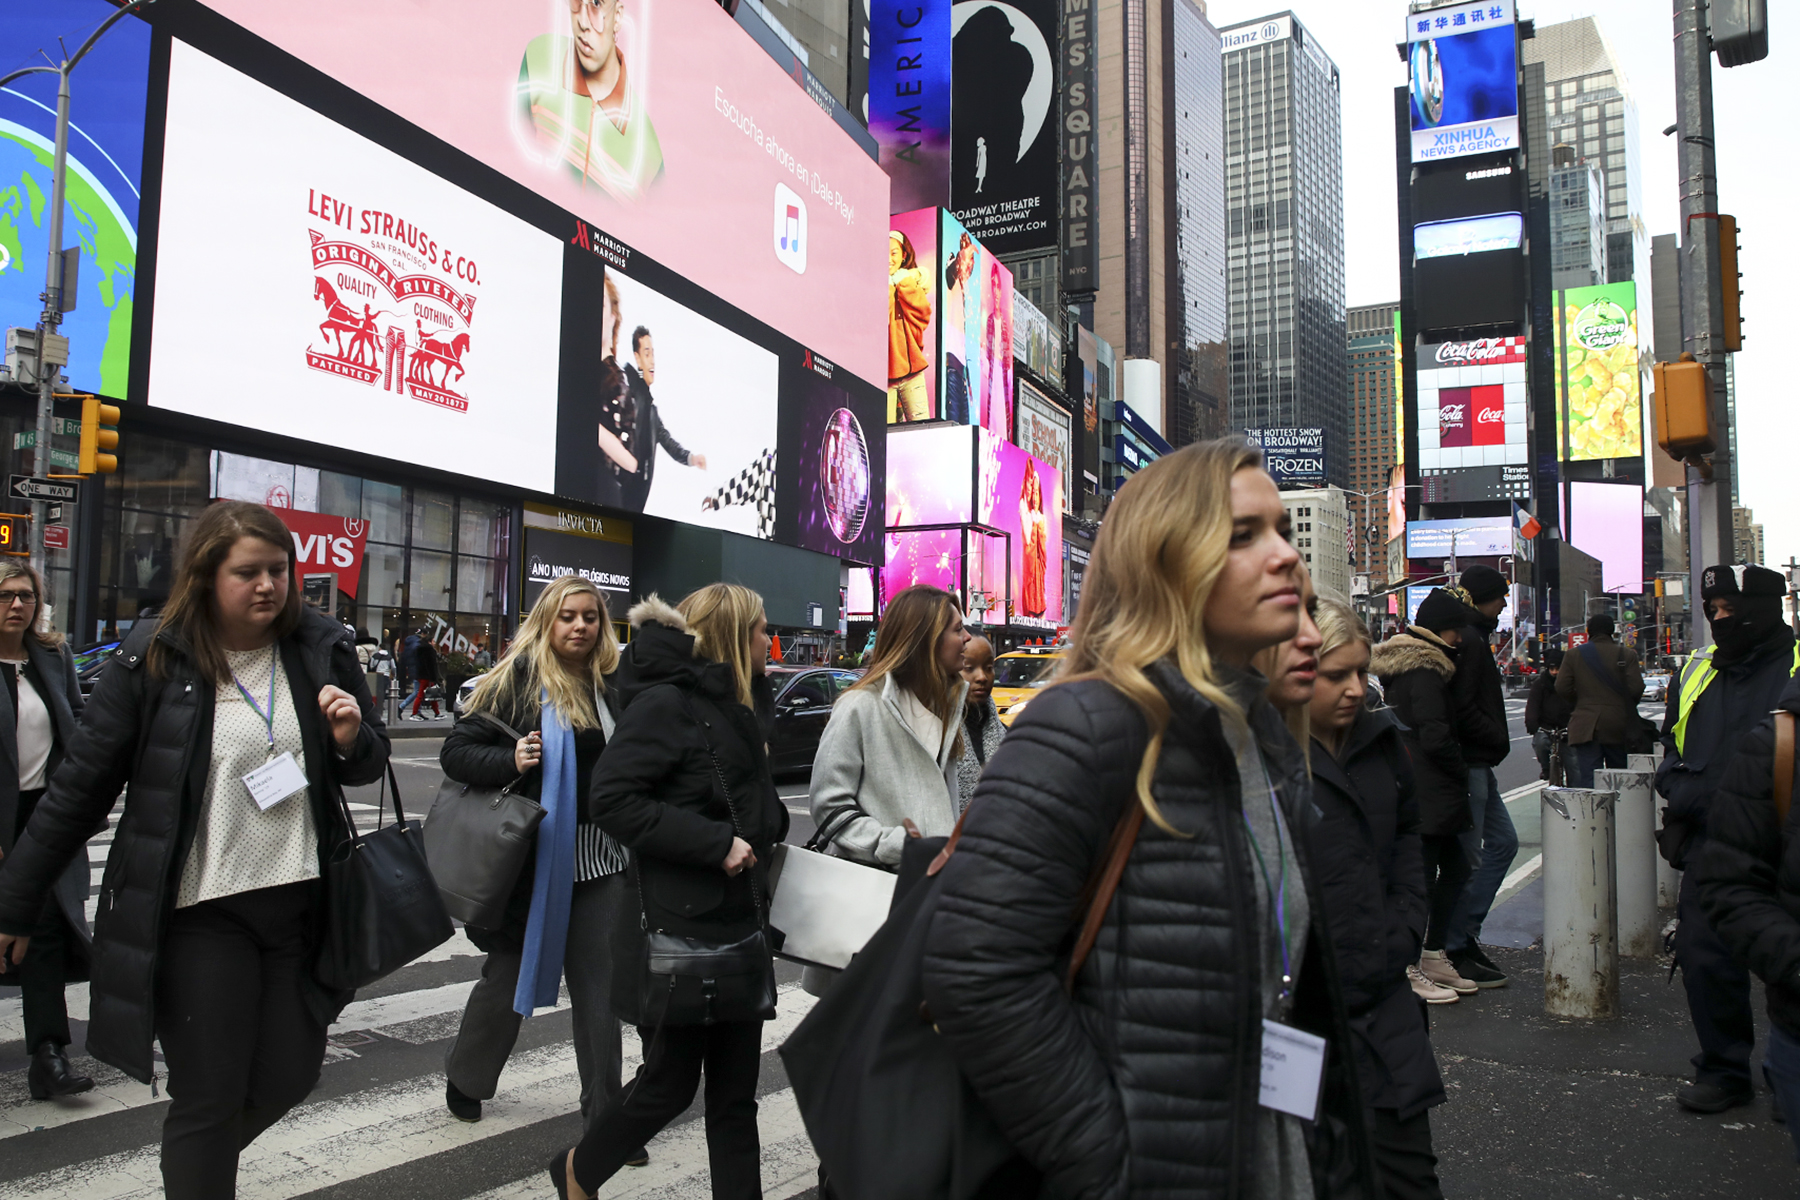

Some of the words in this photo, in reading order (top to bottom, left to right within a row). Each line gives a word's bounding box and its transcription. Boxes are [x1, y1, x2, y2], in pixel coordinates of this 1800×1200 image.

[1416, 5, 1503, 33] 新华通讯社
[806, 72, 836, 108] MARRIOTT
[806, 85, 833, 117] MARQUIS
[1420, 145, 1456, 158] NEWS
[1459, 136, 1511, 153] AGENCY
[1433, 126, 1497, 147] XINHUA
[714, 85, 764, 147] Escucha
[765, 135, 795, 174] ahora
[796, 163, 809, 186] en
[834, 191, 855, 225] Play!
[1065, 82, 1091, 248] SQUARE
[1465, 166, 1512, 180] SAMSUNG
[1000, 196, 1040, 213] THEATRE
[965, 218, 982, 229] AND
[984, 209, 1031, 226] BROADWAY
[308, 188, 353, 231] LEVI
[360, 209, 438, 265] STRAUSS
[441, 249, 453, 274] &
[456, 256, 481, 286] CO.
[593, 231, 631, 258] MARRIOTT
[370, 240, 386, 251] SAN
[388, 244, 427, 271] FRANCISCO
[392, 258, 408, 271] CAL.
[593, 243, 627, 268] MARQUIS
[315, 245, 398, 293] ORIGINAL
[402, 279, 470, 317] RIVETED
[1069, 266, 1088, 275] NYC
[337, 272, 378, 299] QUALITY
[413, 302, 454, 329] CLOTHING
[1580, 323, 1625, 336] Green
[1586, 334, 1627, 348] Giant
[311, 357, 371, 381] PATENTED
[415, 388, 434, 401] MAY
[435, 392, 445, 403] 20
[446, 395, 466, 409] 1873
[20, 434, 26, 446] W
[27, 433, 34, 445] 45
[1247, 429, 1262, 437] THE
[1263, 428, 1297, 437] HOTTEST
[1299, 428, 1322, 436] SNOW
[1247, 437, 1262, 447] ON
[1264, 436, 1323, 447] BROADWAY!
[51, 450, 73, 464] George
[1267, 455, 1323, 475] FROZEN
[1502, 466, 1529, 474] Times
[20, 483, 40, 494] ONE
[49, 486, 70, 496] WAY
[557, 511, 604, 535] INVICTA
[0, 525, 10, 544] 9
[531, 562, 550, 577] ANO
[578, 567, 610, 584] RELÓGIOS
[609, 573, 630, 587] NOVOS
[424, 612, 436, 629] HE
[250, 775, 273, 791] Mikaela
